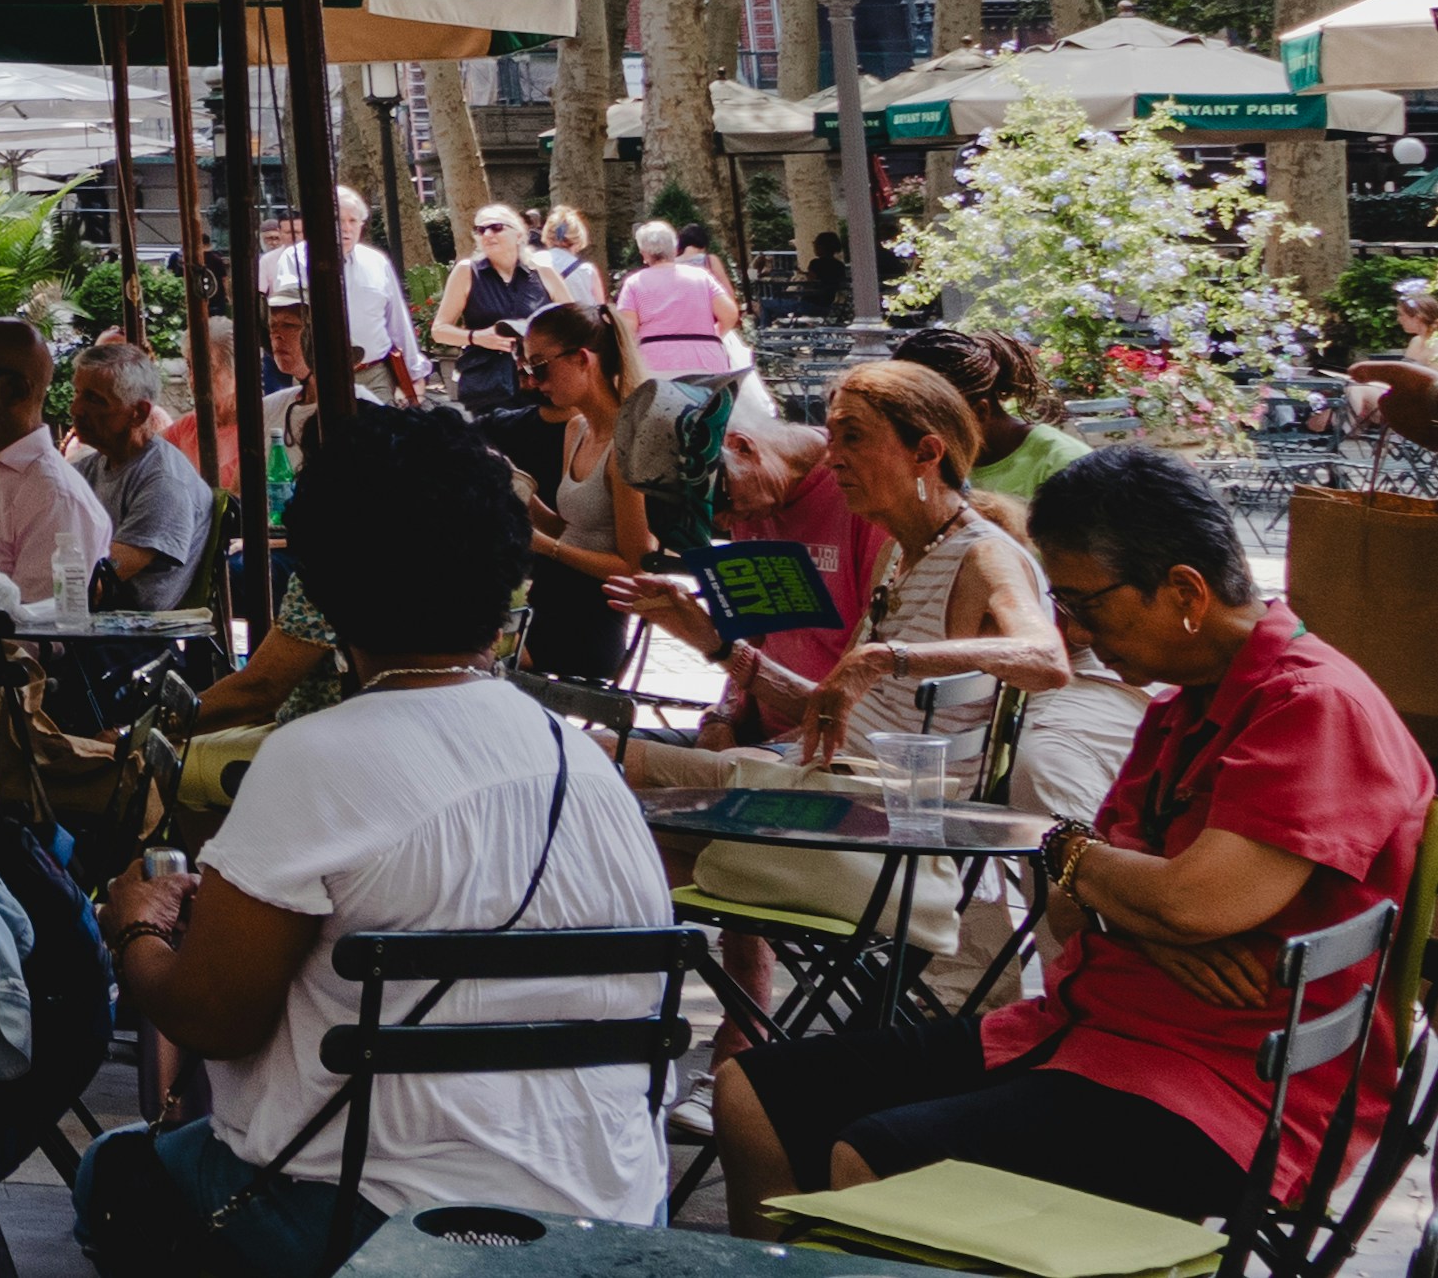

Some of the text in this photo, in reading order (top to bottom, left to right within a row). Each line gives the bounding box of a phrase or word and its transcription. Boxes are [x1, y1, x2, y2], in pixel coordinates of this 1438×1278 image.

[1246, 104, 1298, 115] PARK
[716, 558, 776, 615] CITY
[753, 556, 792, 613] FOR THE
[770, 556, 815, 612] SUMMER
